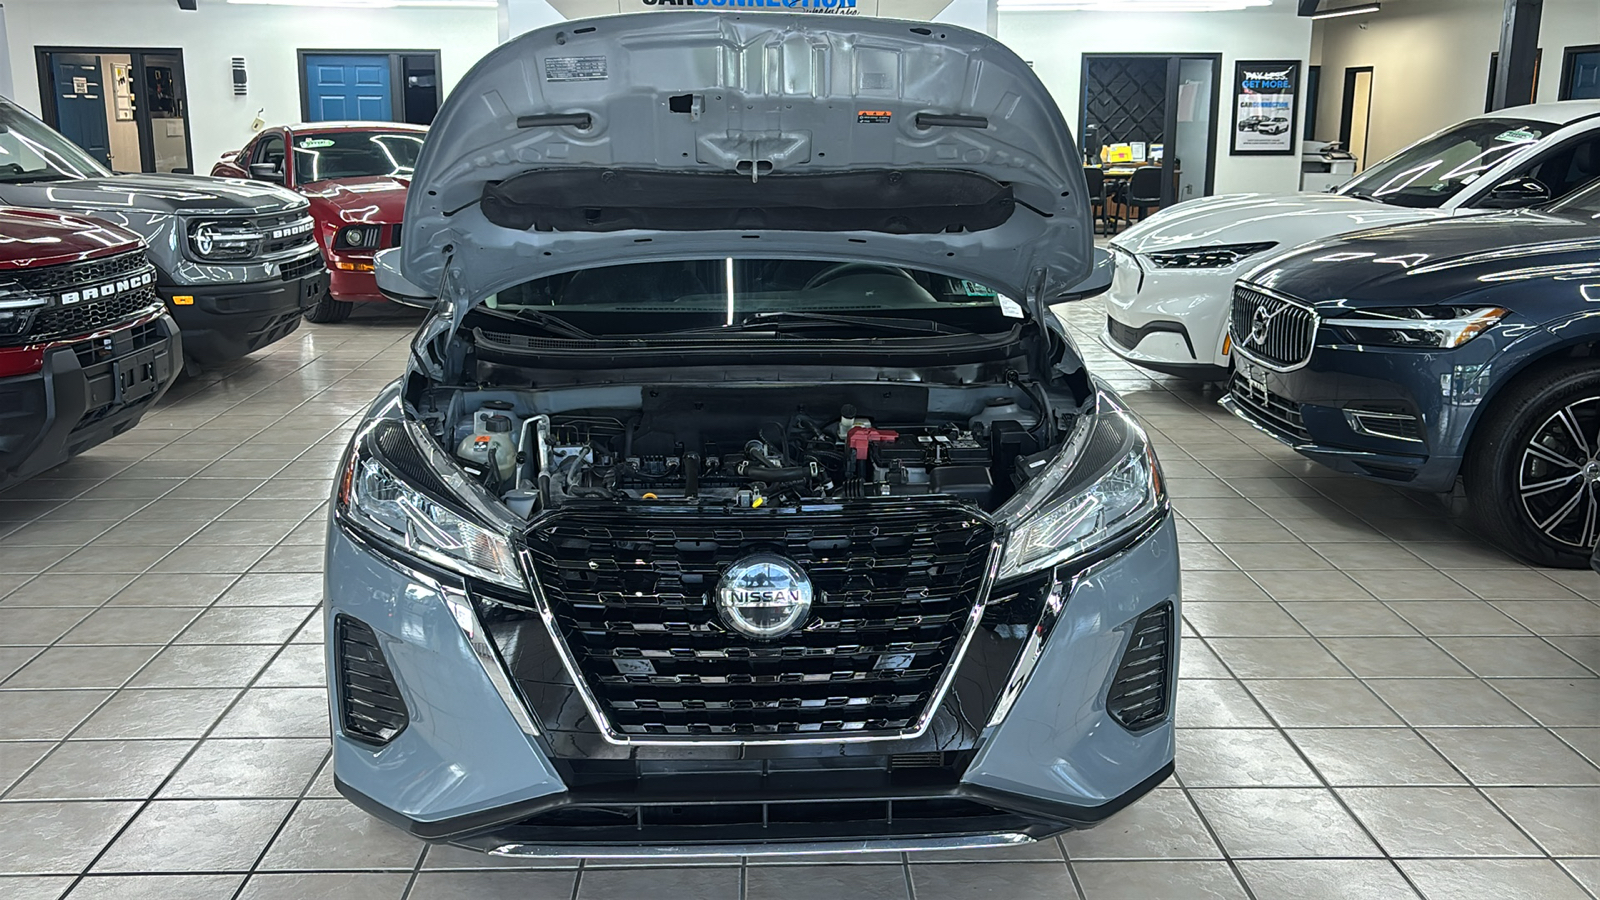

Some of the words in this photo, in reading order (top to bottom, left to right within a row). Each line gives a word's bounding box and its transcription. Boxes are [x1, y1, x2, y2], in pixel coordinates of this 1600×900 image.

[1242, 80, 1260, 88] GET
[1262, 80, 1291, 88] MORE.
[61, 273, 151, 305] BRONCO
[731, 591, 799, 602] NISSAN
